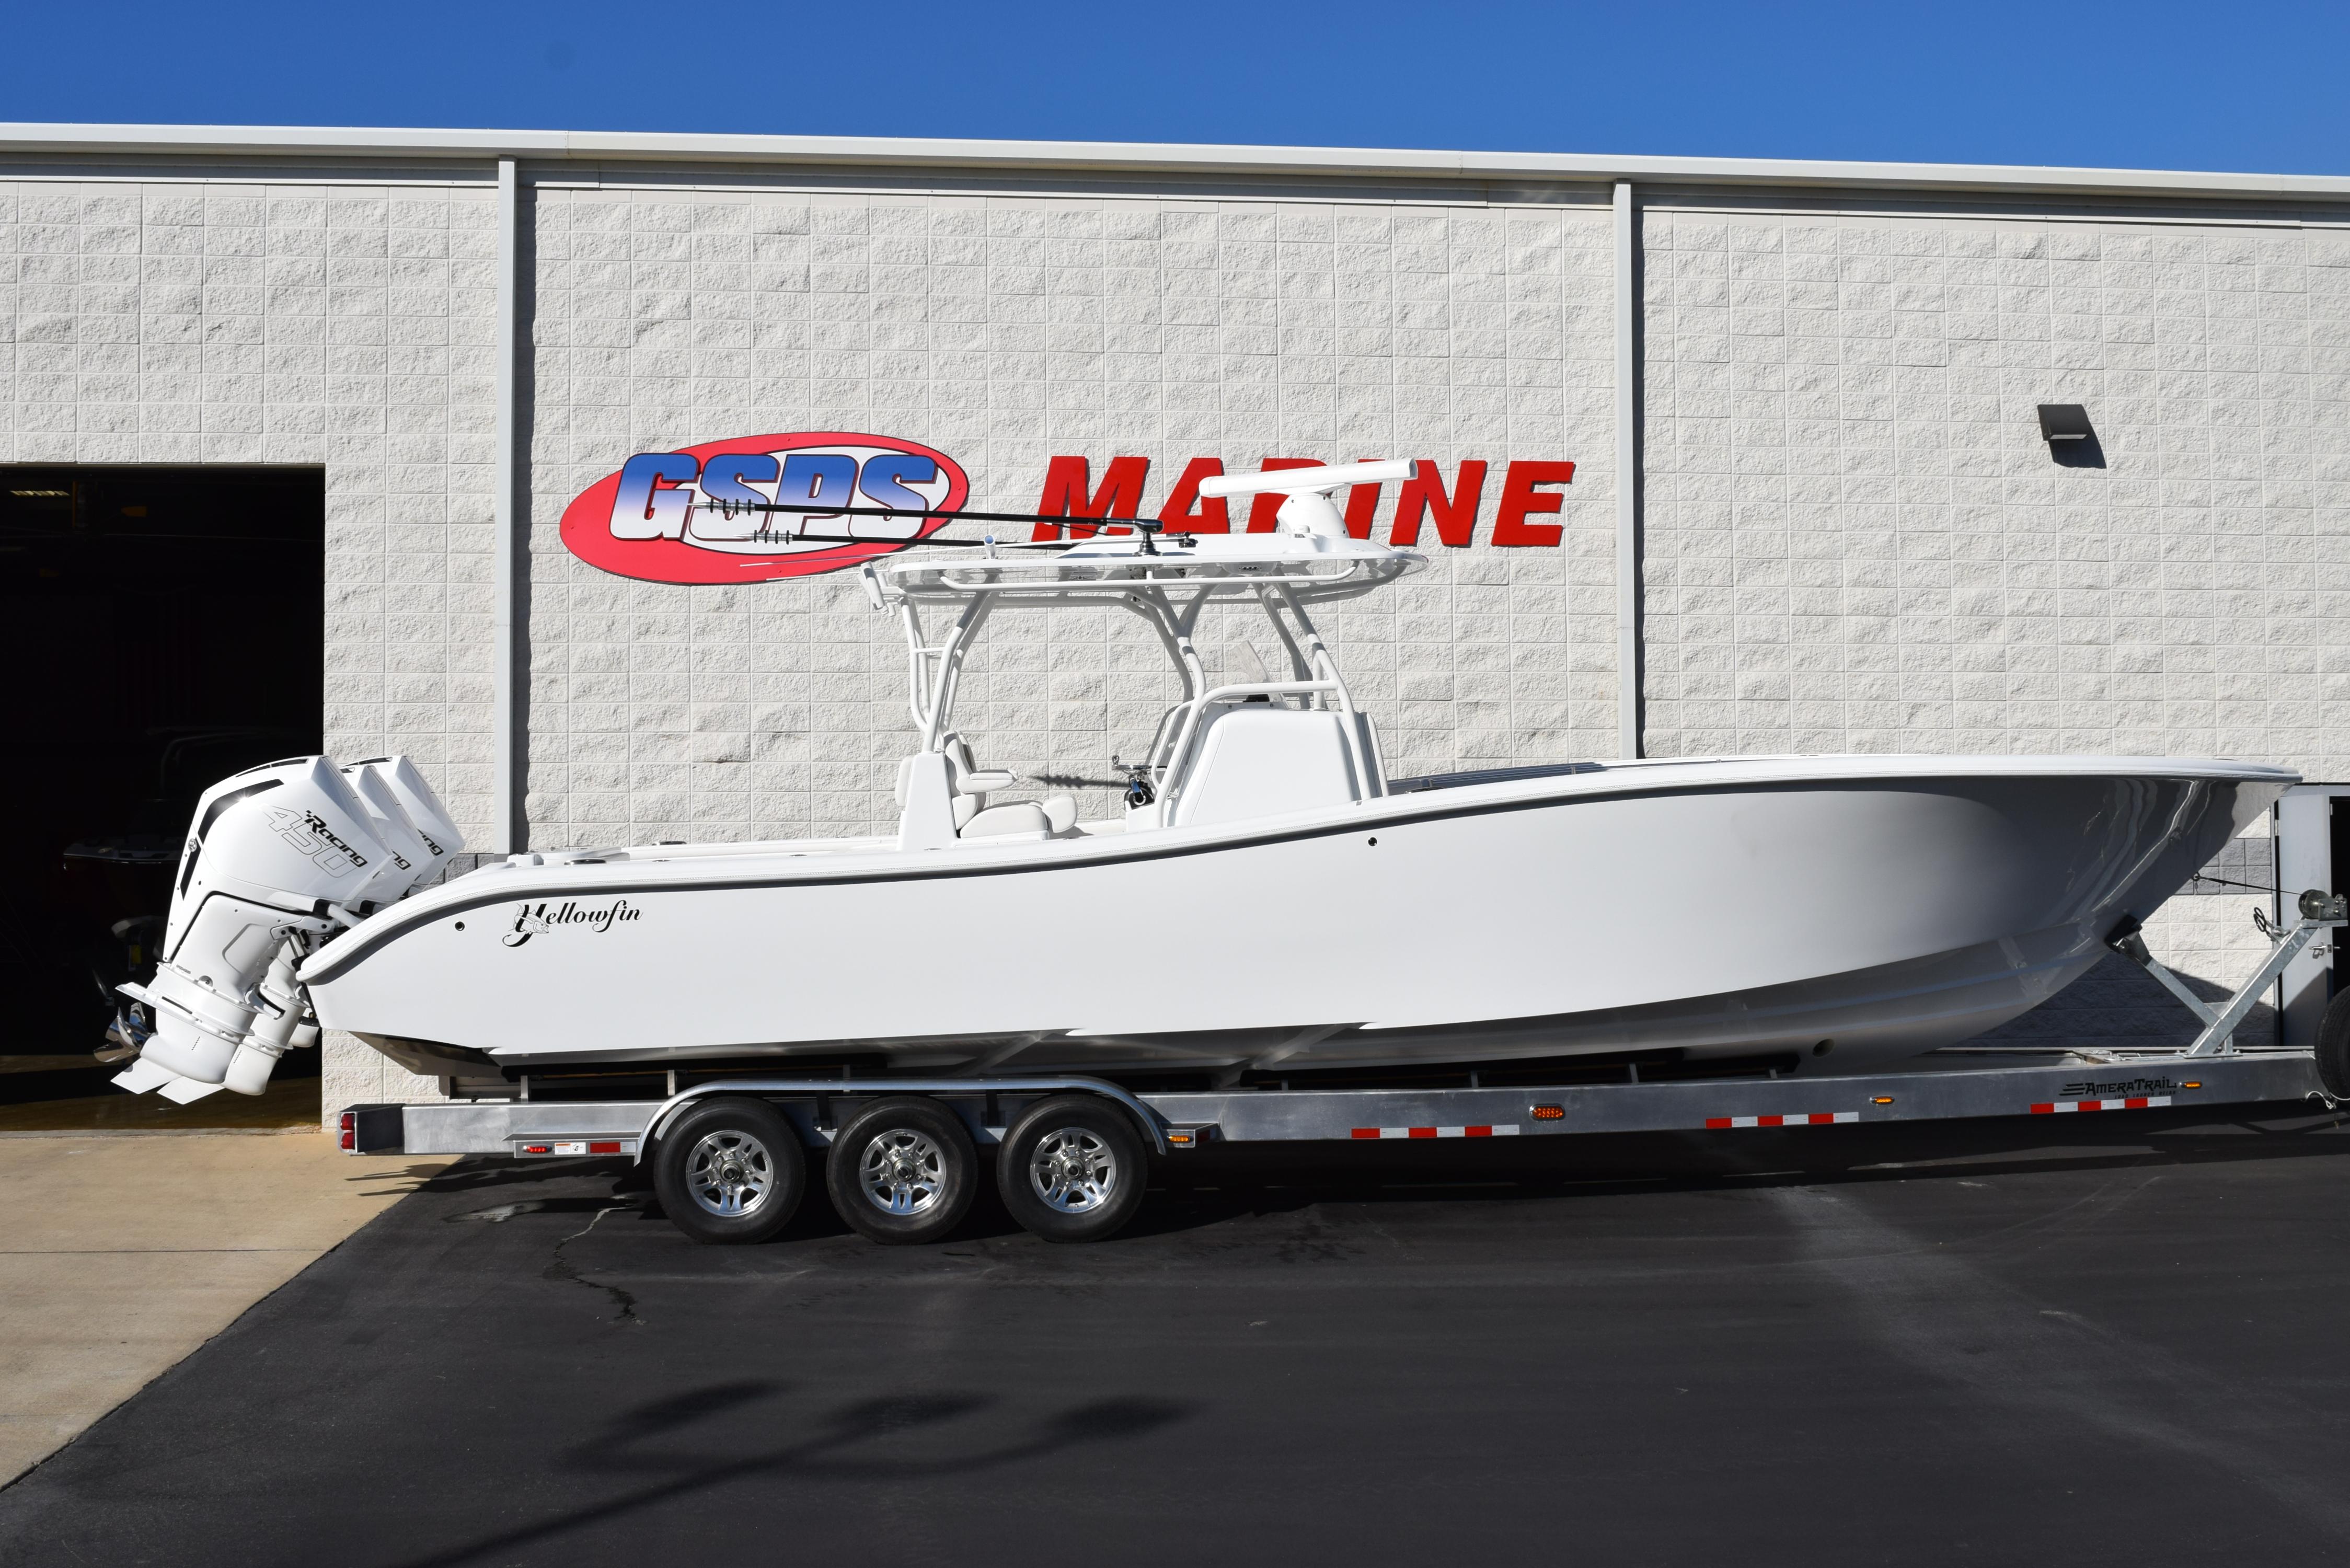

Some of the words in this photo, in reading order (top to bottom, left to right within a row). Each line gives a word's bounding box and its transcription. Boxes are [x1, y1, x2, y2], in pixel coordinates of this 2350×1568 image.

[609, 453, 939, 540] GSPS
[258, 804, 360, 878] 450
[304, 810, 368, 868] Racing
[502, 900, 643, 948] Yellowfin
